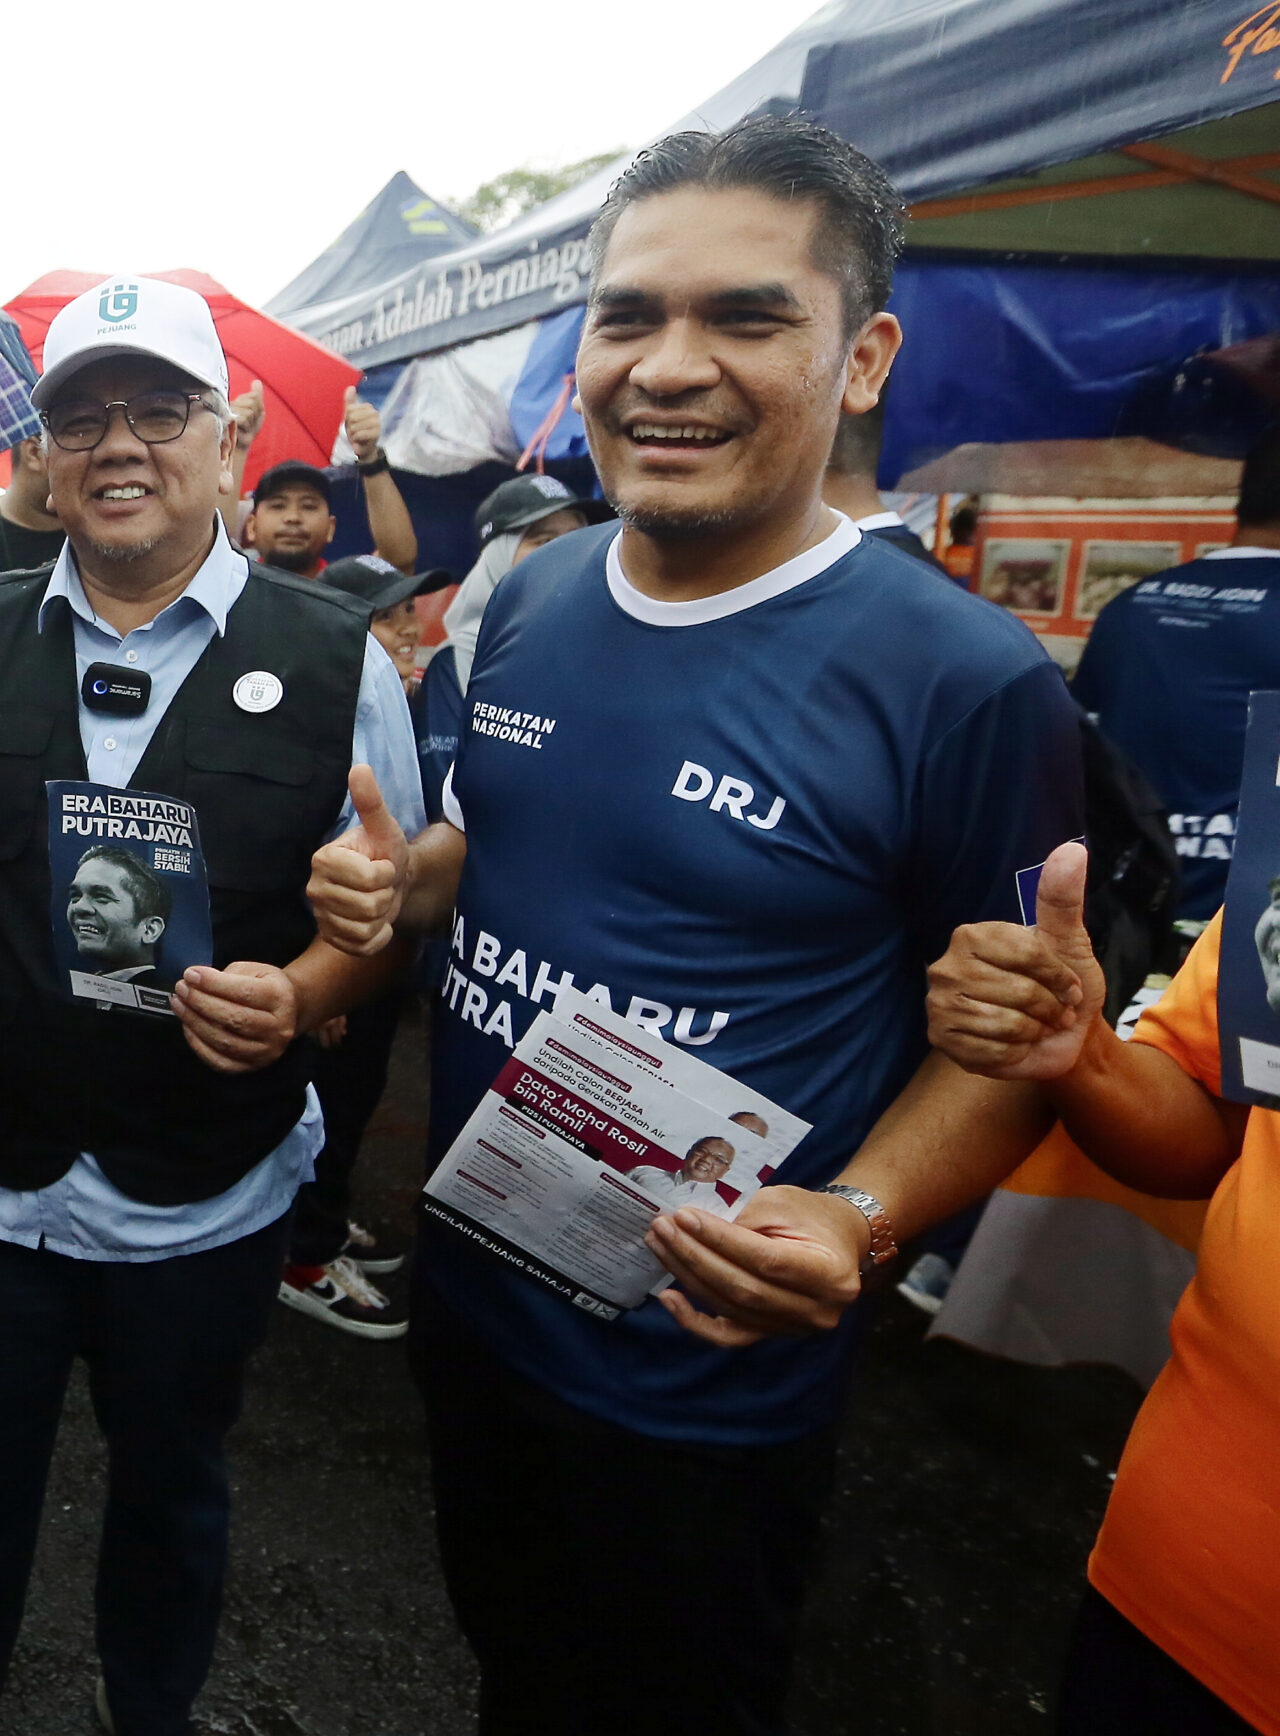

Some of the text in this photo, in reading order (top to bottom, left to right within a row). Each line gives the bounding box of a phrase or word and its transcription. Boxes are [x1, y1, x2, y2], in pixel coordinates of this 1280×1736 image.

[367, 270, 454, 345] Adalah
[97, 323, 137, 335] PEJUANG
[472, 717, 543, 750] NASIONAL
[473, 701, 557, 734] PERIKATAN
[62, 794, 189, 825] ERA BAHARU
[671, 760, 786, 831] DRJ
[62, 815, 193, 848] PUTRAJAYA
[154, 853, 190, 865] BERSIH
[154, 861, 190, 873] STABIL
[533, 1056, 576, 1086] daripada
[577, 1083, 618, 1111] Gerakan
[619, 1107, 650, 1131] Tanah
[650, 1127, 666, 1140] Air
[538, 1048, 574, 1074] Undilah
[575, 1070, 608, 1092] Calon
[604, 1087, 644, 1116] BERJASA
[513, 1082, 586, 1133] bin Ramli
[541, 1118, 586, 1150] PUTRAJAYA
[563, 1098, 609, 1132] Mohd
[607, 1127, 649, 1157] Rosli
[424, 1203, 572, 1297] UNDILAH PEJUANG SAHAJA
